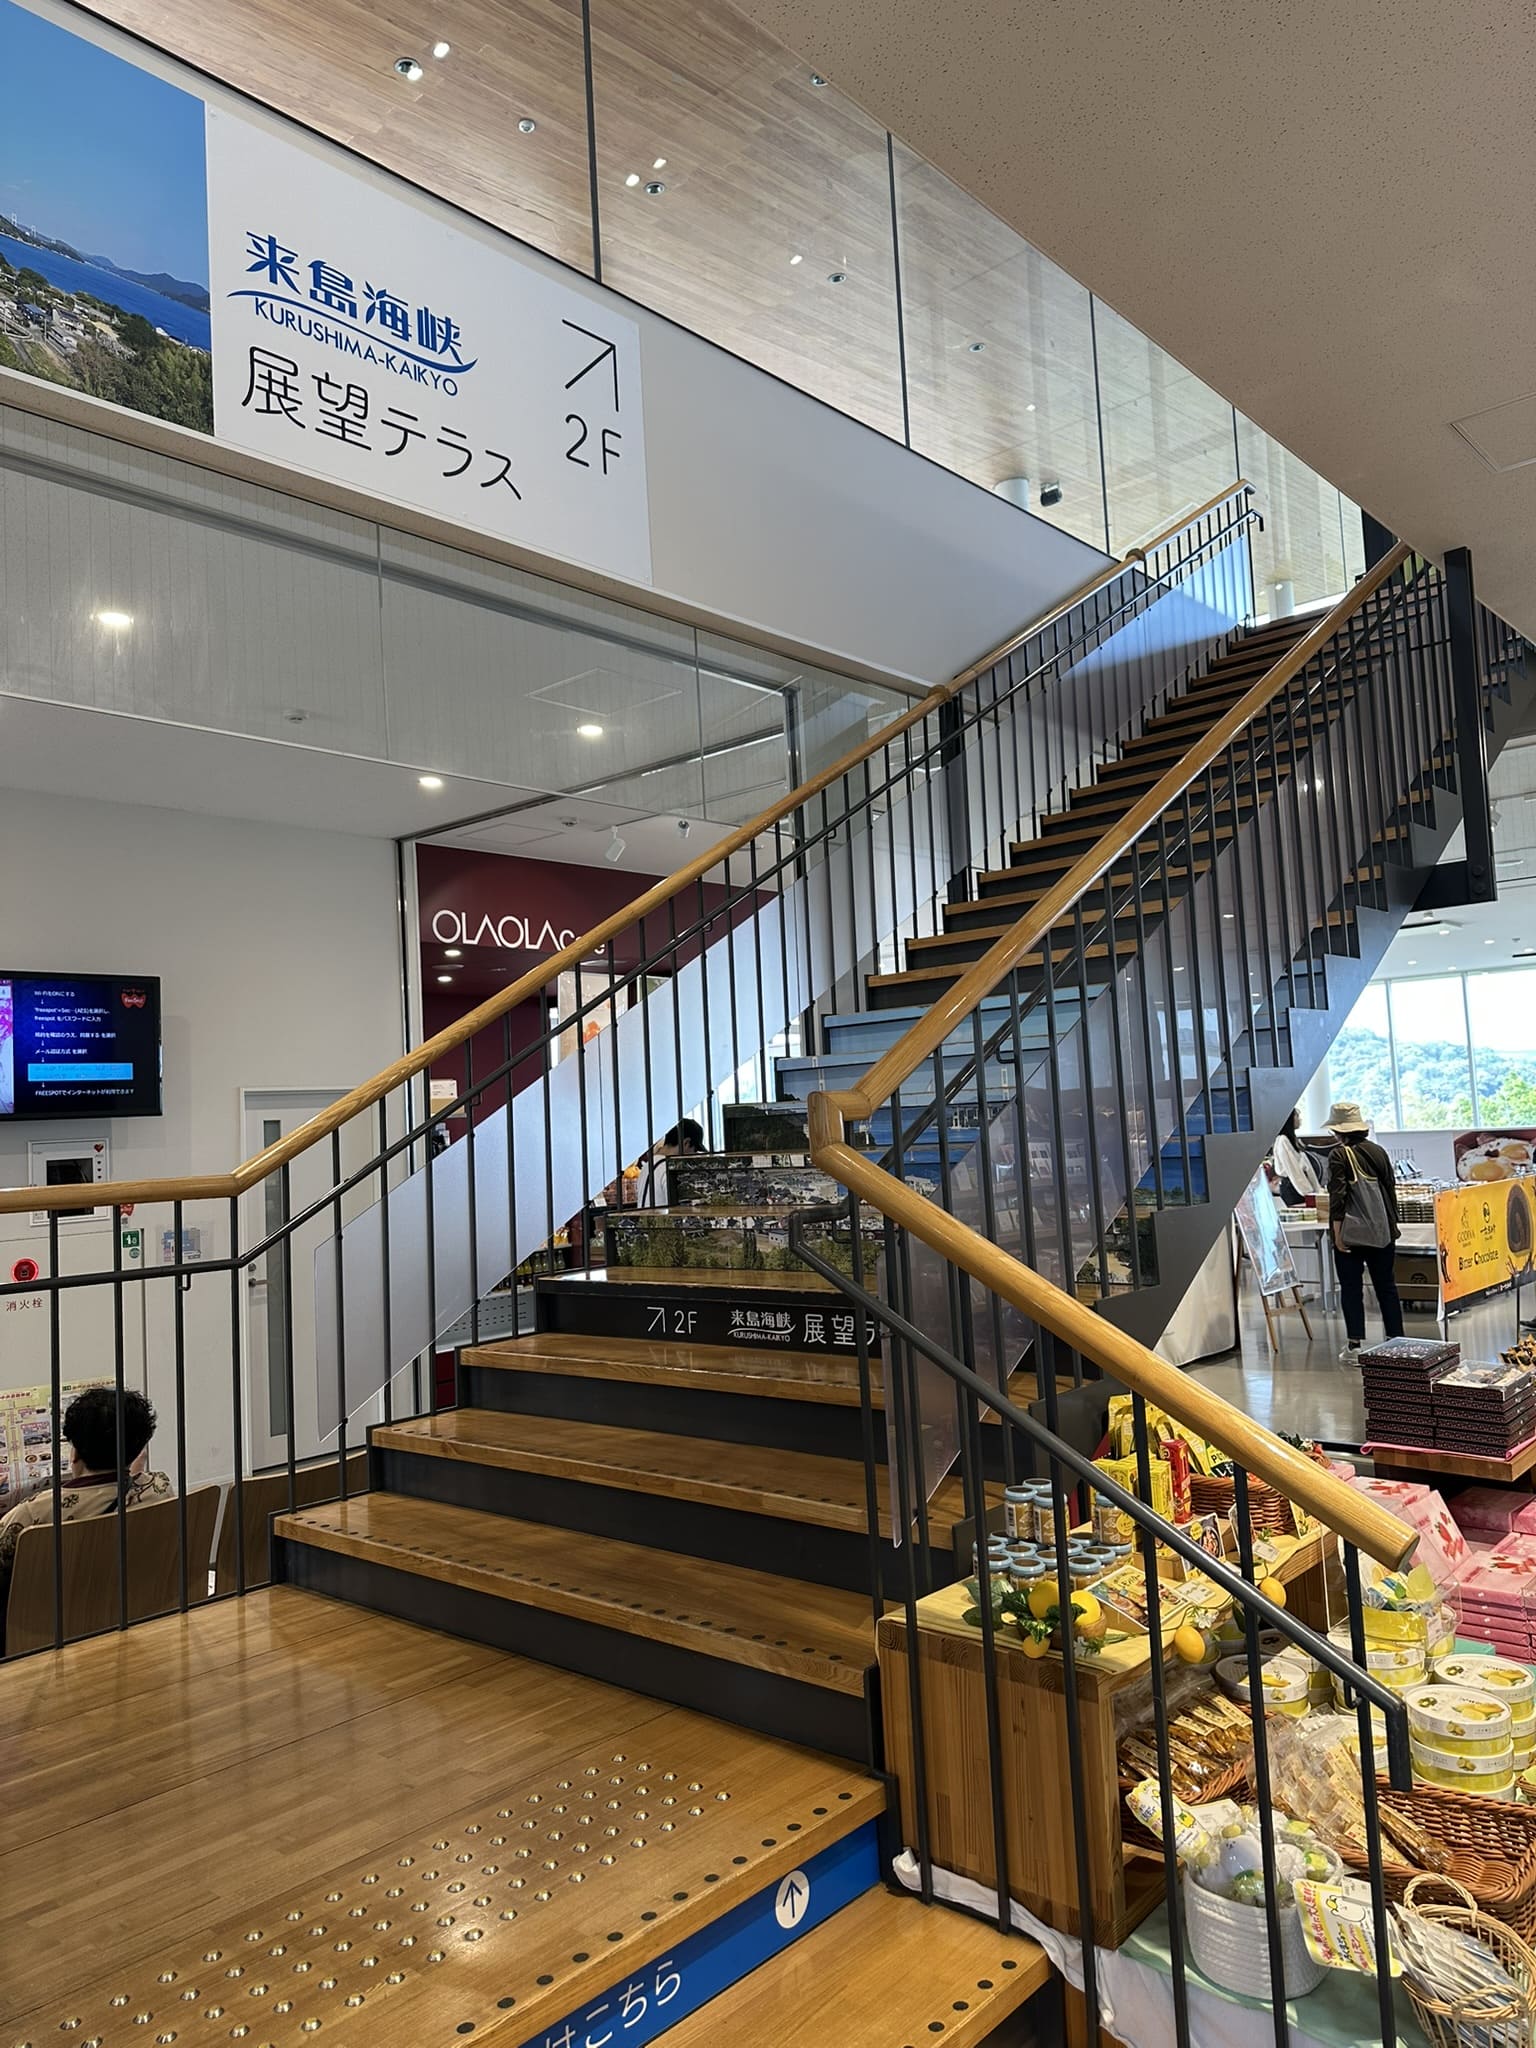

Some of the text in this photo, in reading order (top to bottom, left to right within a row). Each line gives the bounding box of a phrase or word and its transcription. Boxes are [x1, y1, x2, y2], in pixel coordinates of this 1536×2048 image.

[245, 231, 462, 364] 来島海峡
[254, 297, 459, 397] KURUSHIMA-KAIKYO
[241, 345, 522, 500] 展望テラス
[565, 414, 622, 475] 2F
[6, 1297, 43, 1312] 消火栓
[673, 1309, 698, 1335] 2F
[730, 1308, 792, 1329] 来島海峡
[733, 1330, 791, 1343] KURUSHIMA-KAIKYO
